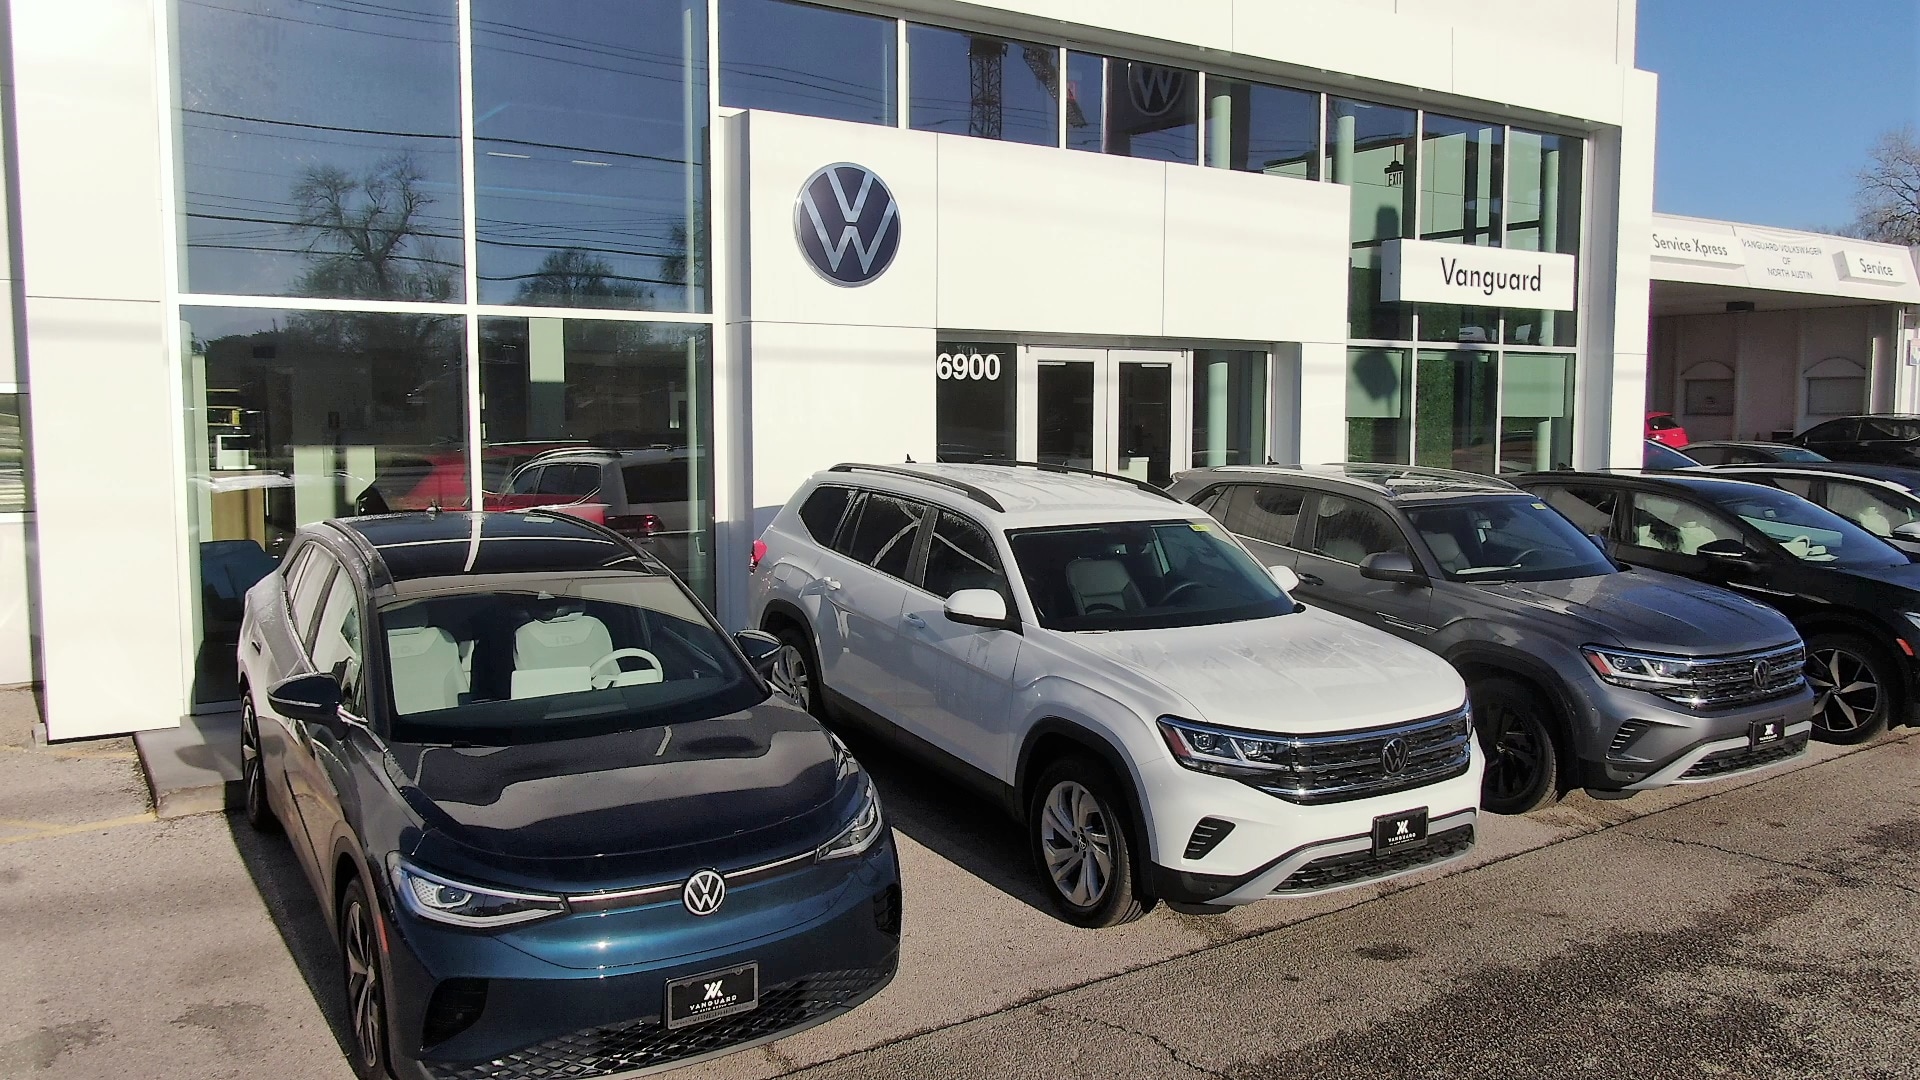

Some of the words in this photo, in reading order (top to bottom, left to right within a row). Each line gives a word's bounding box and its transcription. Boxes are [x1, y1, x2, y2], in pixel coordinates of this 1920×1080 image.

[1388, 171, 1403, 187] EXIT
[799, 165, 898, 275] VW
[1652, 233, 1691, 252] Service
[1692, 238, 1728, 257] Xpress
[1740, 238, 1779, 252] VANGUARD
[1780, 243, 1822, 256] VOLKSWAGEN
[1782, 256, 1791, 265] OF
[1859, 257, 1894, 276] Service
[1440, 256, 1541, 296] Vanguard
[1767, 267, 1790, 277] NORTH
[1791, 270, 1813, 279] AUSTIN
[936, 352, 1001, 381] 6900
[686, 872, 723, 912] VW
[689, 994, 737, 1011] VANGUARD
